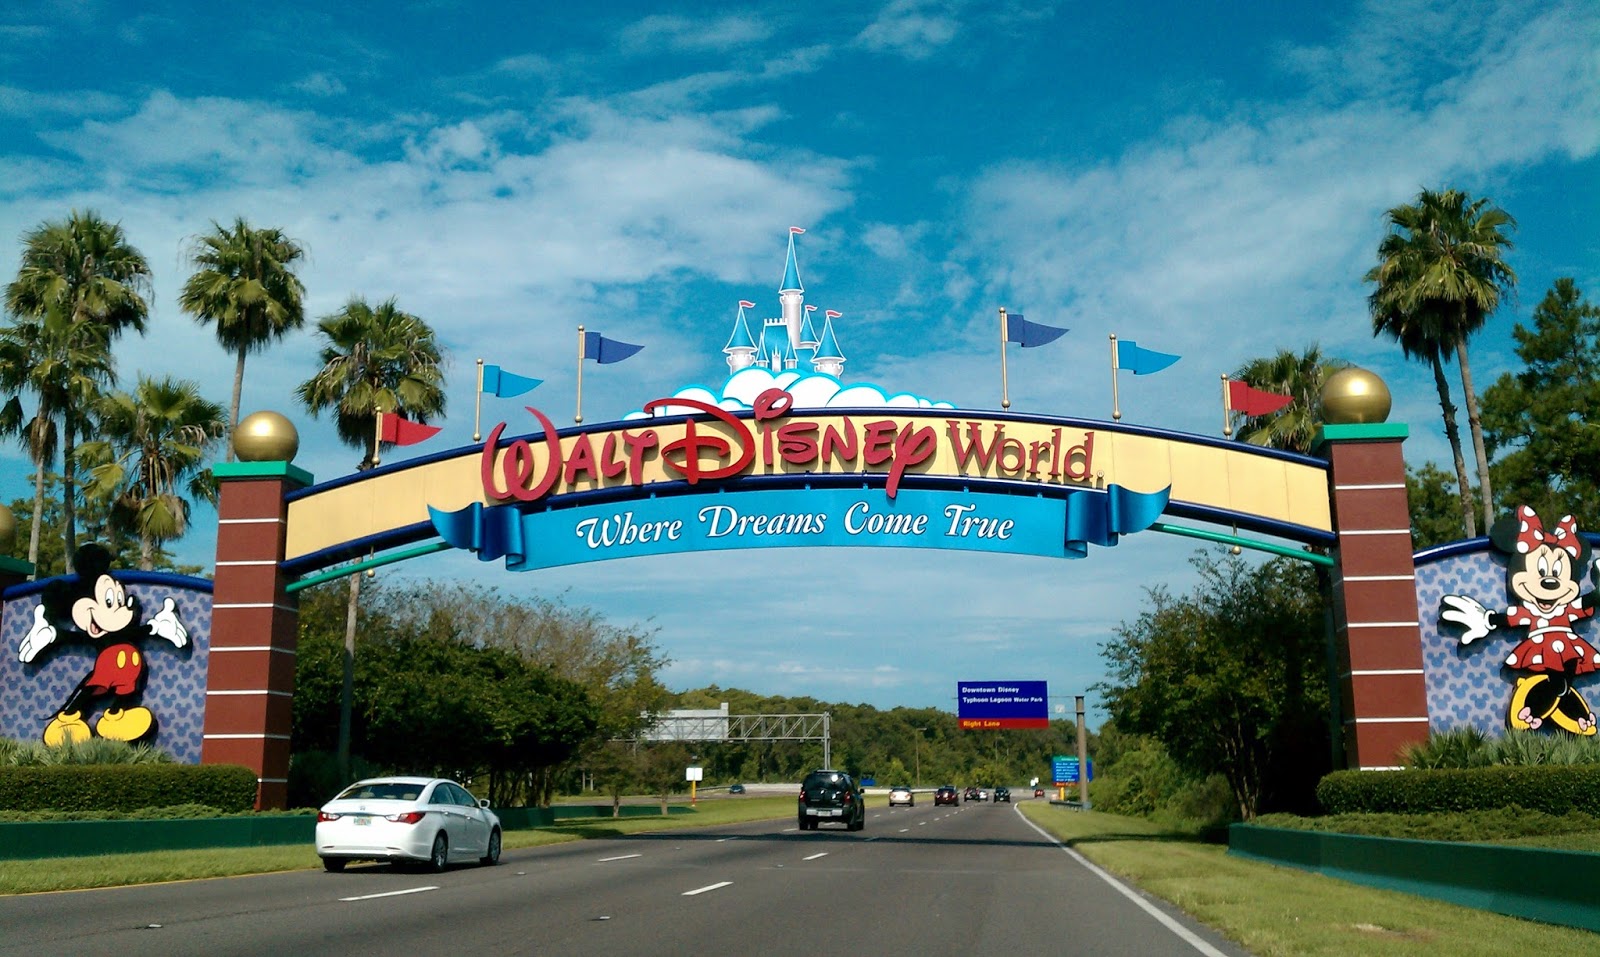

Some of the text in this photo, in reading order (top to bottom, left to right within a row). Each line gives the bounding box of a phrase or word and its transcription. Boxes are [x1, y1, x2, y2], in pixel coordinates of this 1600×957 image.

[946, 420, 1094, 479] World
[576, 500, 1015, 549] Where Dreams Come True
